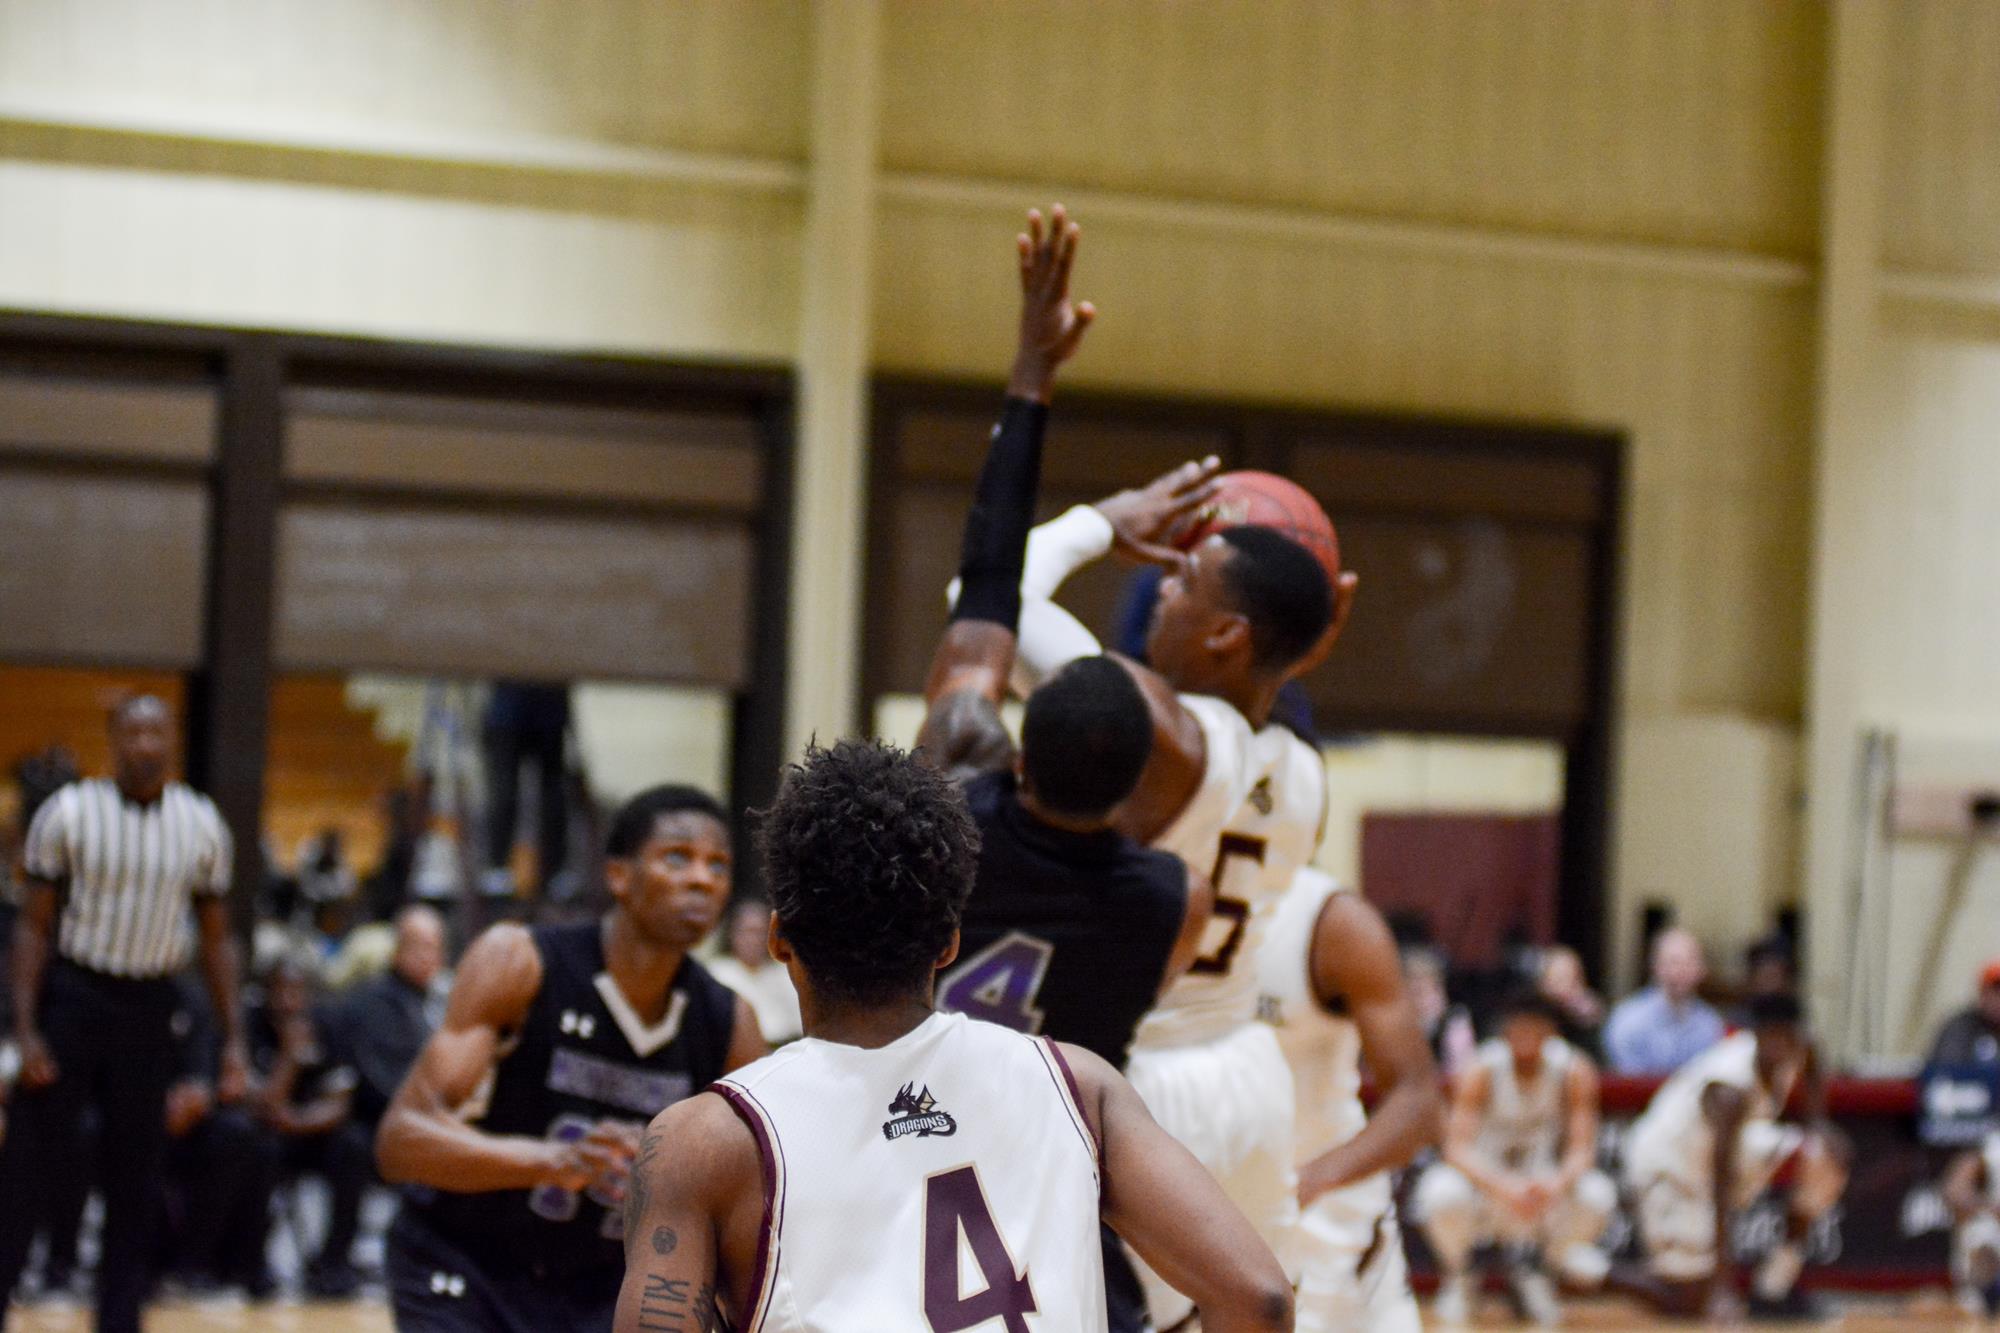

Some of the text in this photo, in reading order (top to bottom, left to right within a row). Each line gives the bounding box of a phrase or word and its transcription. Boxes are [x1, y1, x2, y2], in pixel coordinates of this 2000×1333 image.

[1187, 831, 1268, 975] 5
[936, 931, 1054, 1036] 4
[890, 1114, 948, 1139] DRAGONS
[920, 1161, 1041, 1333] 4
